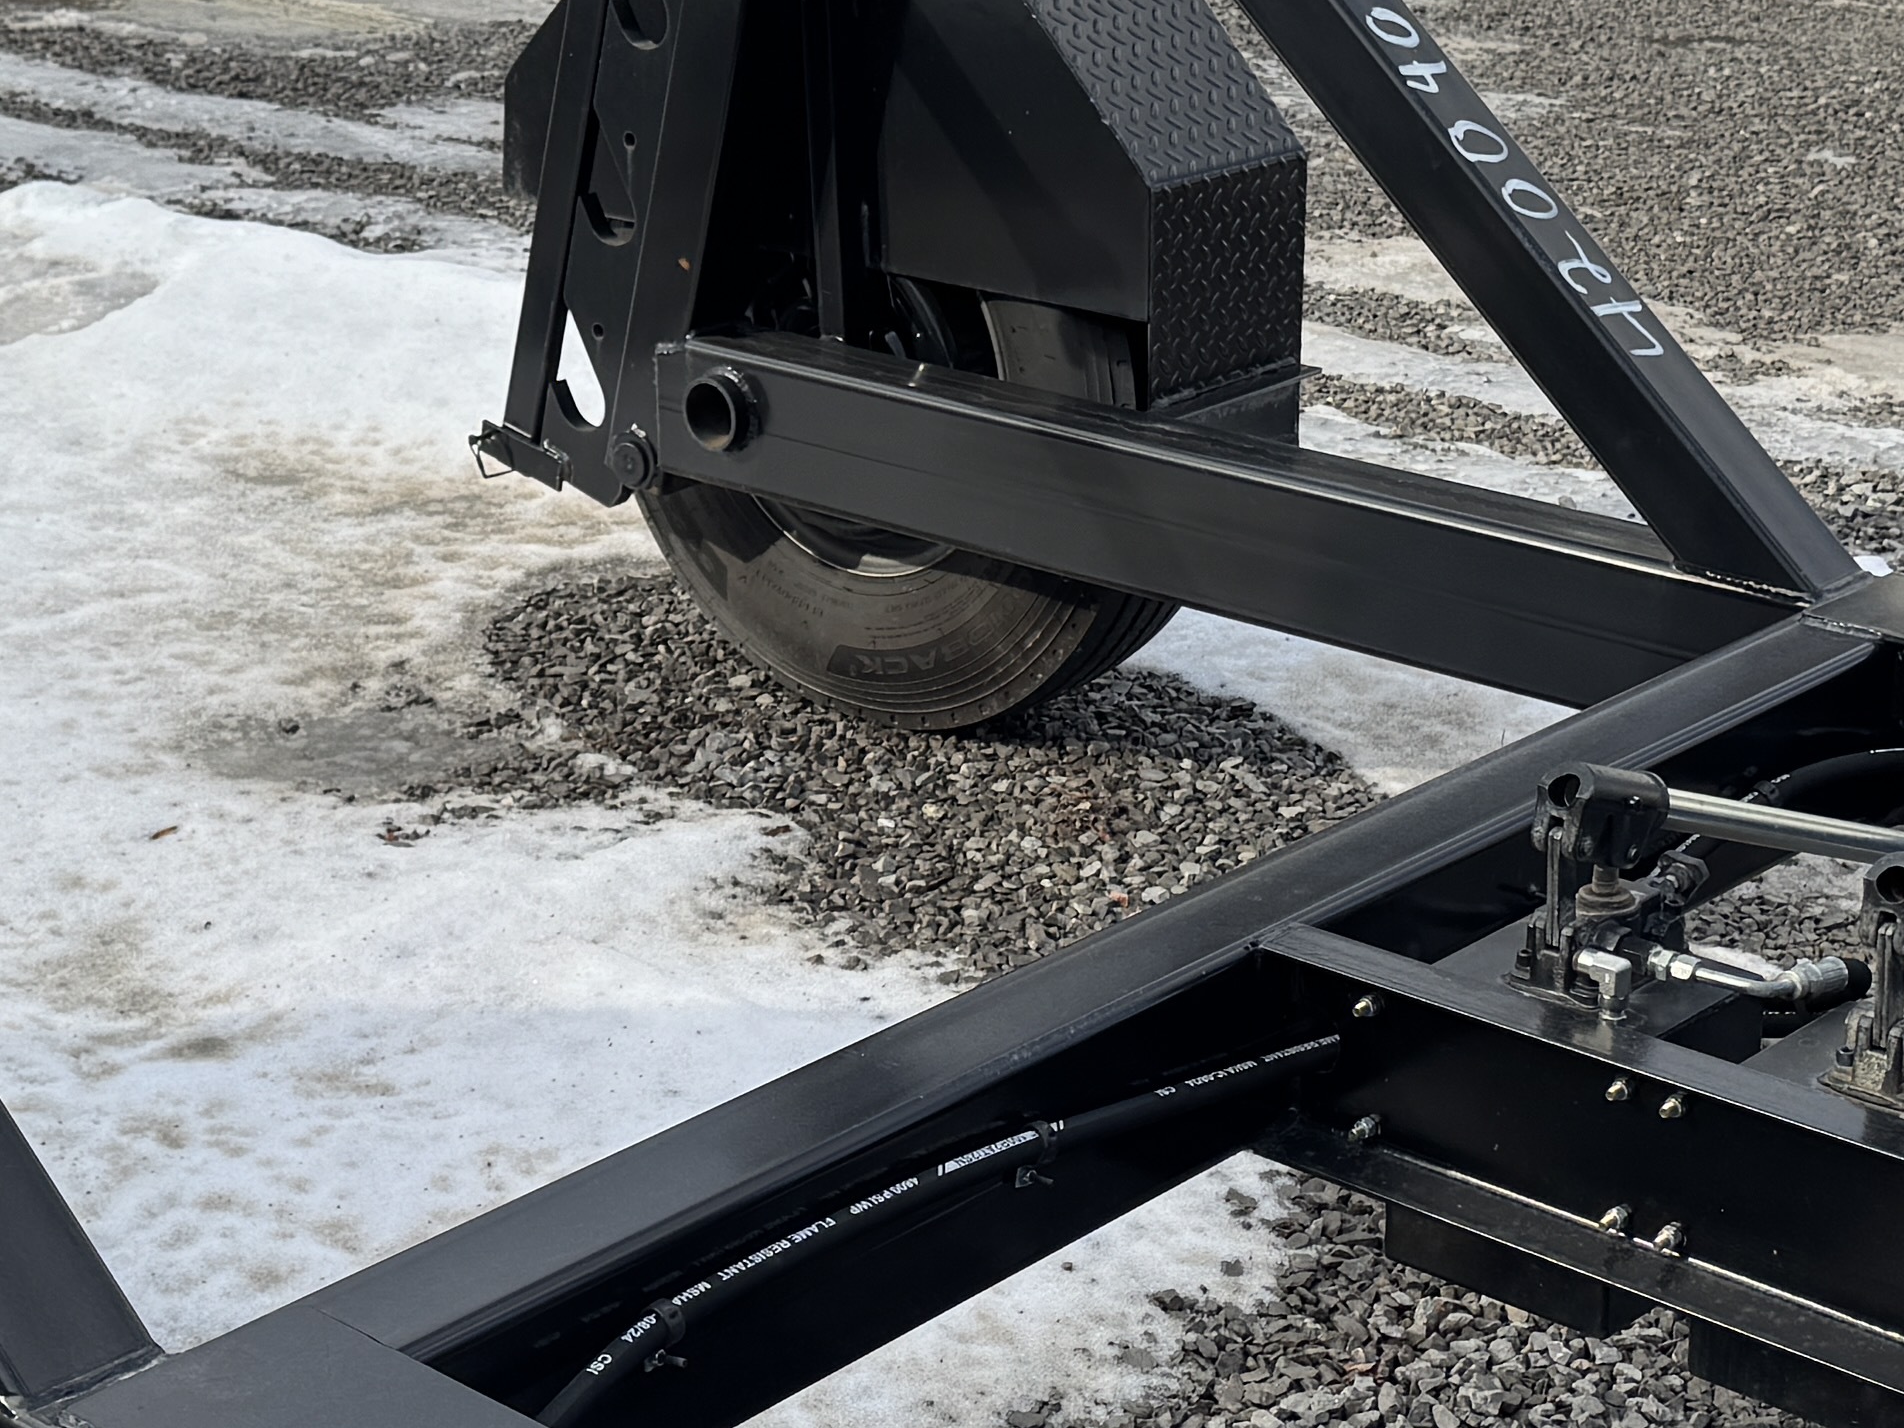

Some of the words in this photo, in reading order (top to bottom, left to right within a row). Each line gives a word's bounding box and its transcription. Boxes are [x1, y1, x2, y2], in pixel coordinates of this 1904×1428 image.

[848, 1200, 873, 1215] WP
[867, 1189, 892, 1206] PSI
[788, 1217, 837, 1245] FLAME
[717, 1239, 792, 1281] RESISTANT
[671, 1281, 712, 1306] MSHA
[585, 1353, 613, 1376] CSI
